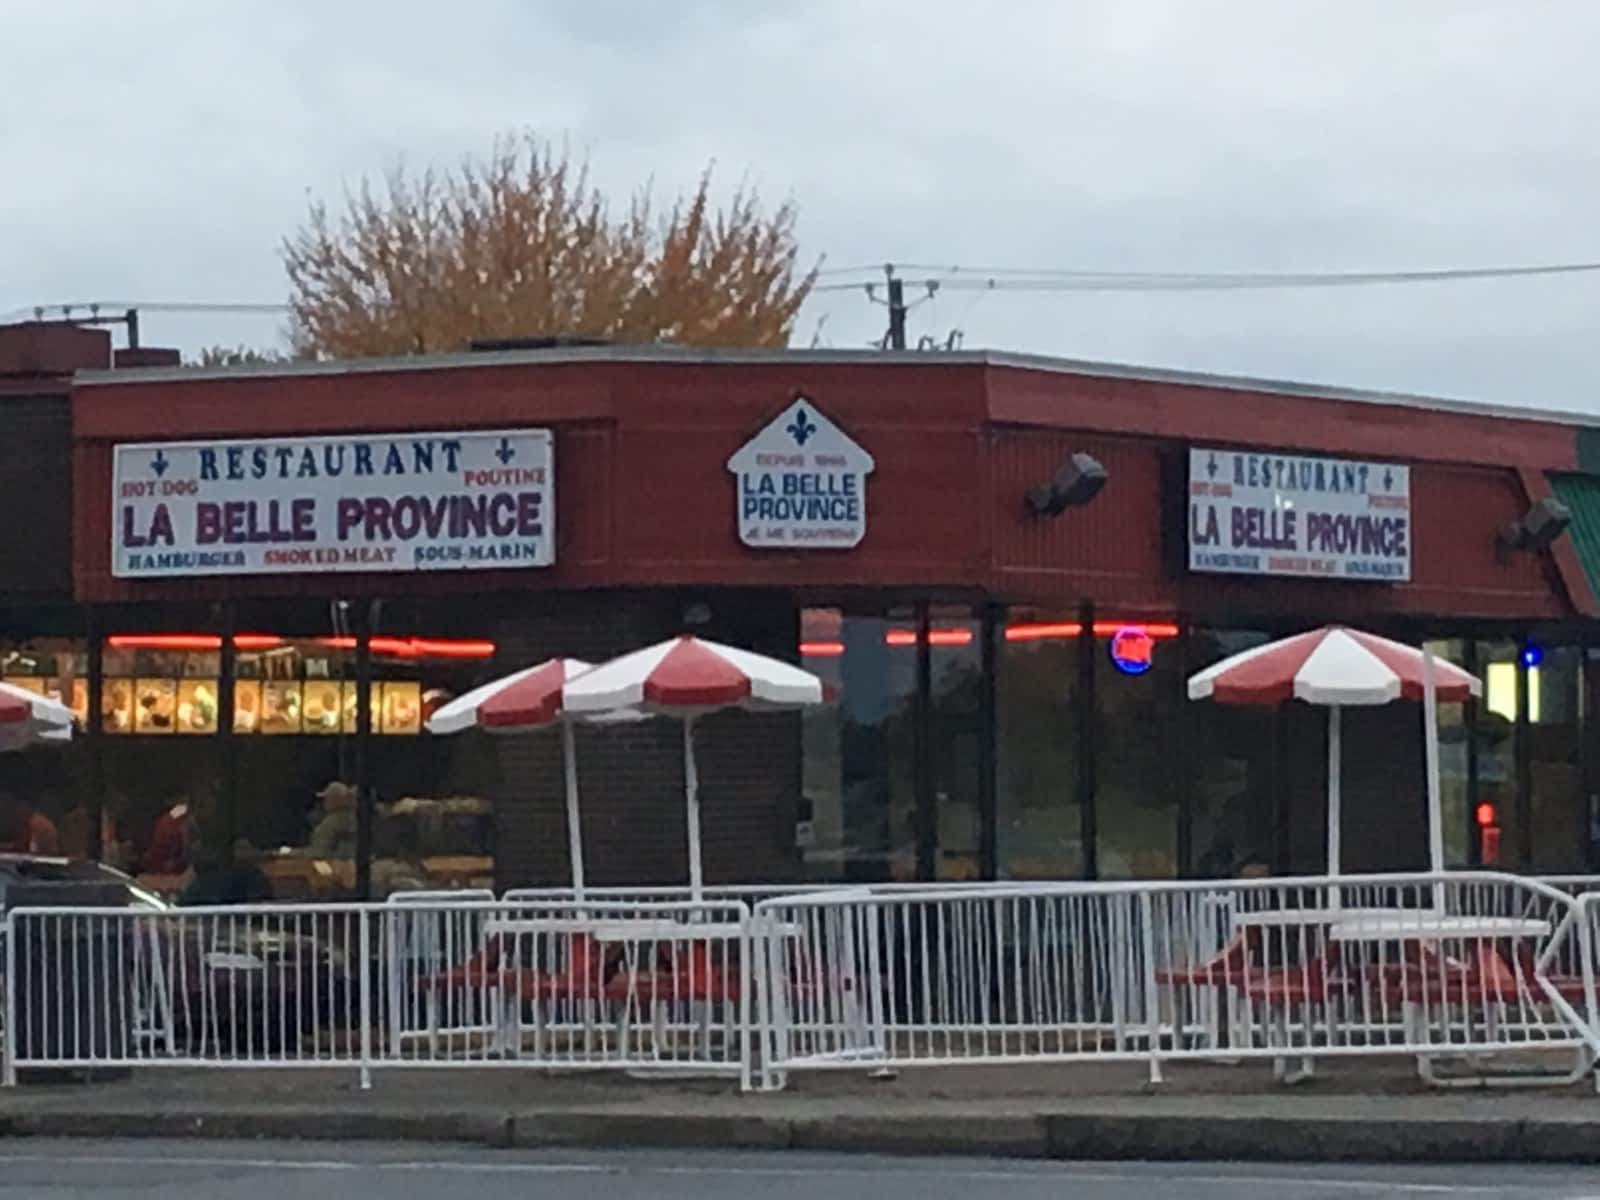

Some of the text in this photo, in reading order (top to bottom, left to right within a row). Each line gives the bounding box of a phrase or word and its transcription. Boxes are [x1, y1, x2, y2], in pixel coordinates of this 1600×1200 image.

[199, 440, 462, 480] RESTAURANT
[464, 467, 545, 487] POUTINE
[743, 473, 856, 496] LA BELLE
[1233, 456, 1368, 494] RESTAURANT
[121, 480, 199, 497] HOT DOG
[122, 492, 543, 547] LA BELLE PROVINCE
[743, 497, 859, 521] PROVINCE
[1192, 504, 1406, 557] LA BELLE PROVINCE
[128, 547, 397, 569] HAMBURGER SMOKED MEAT
